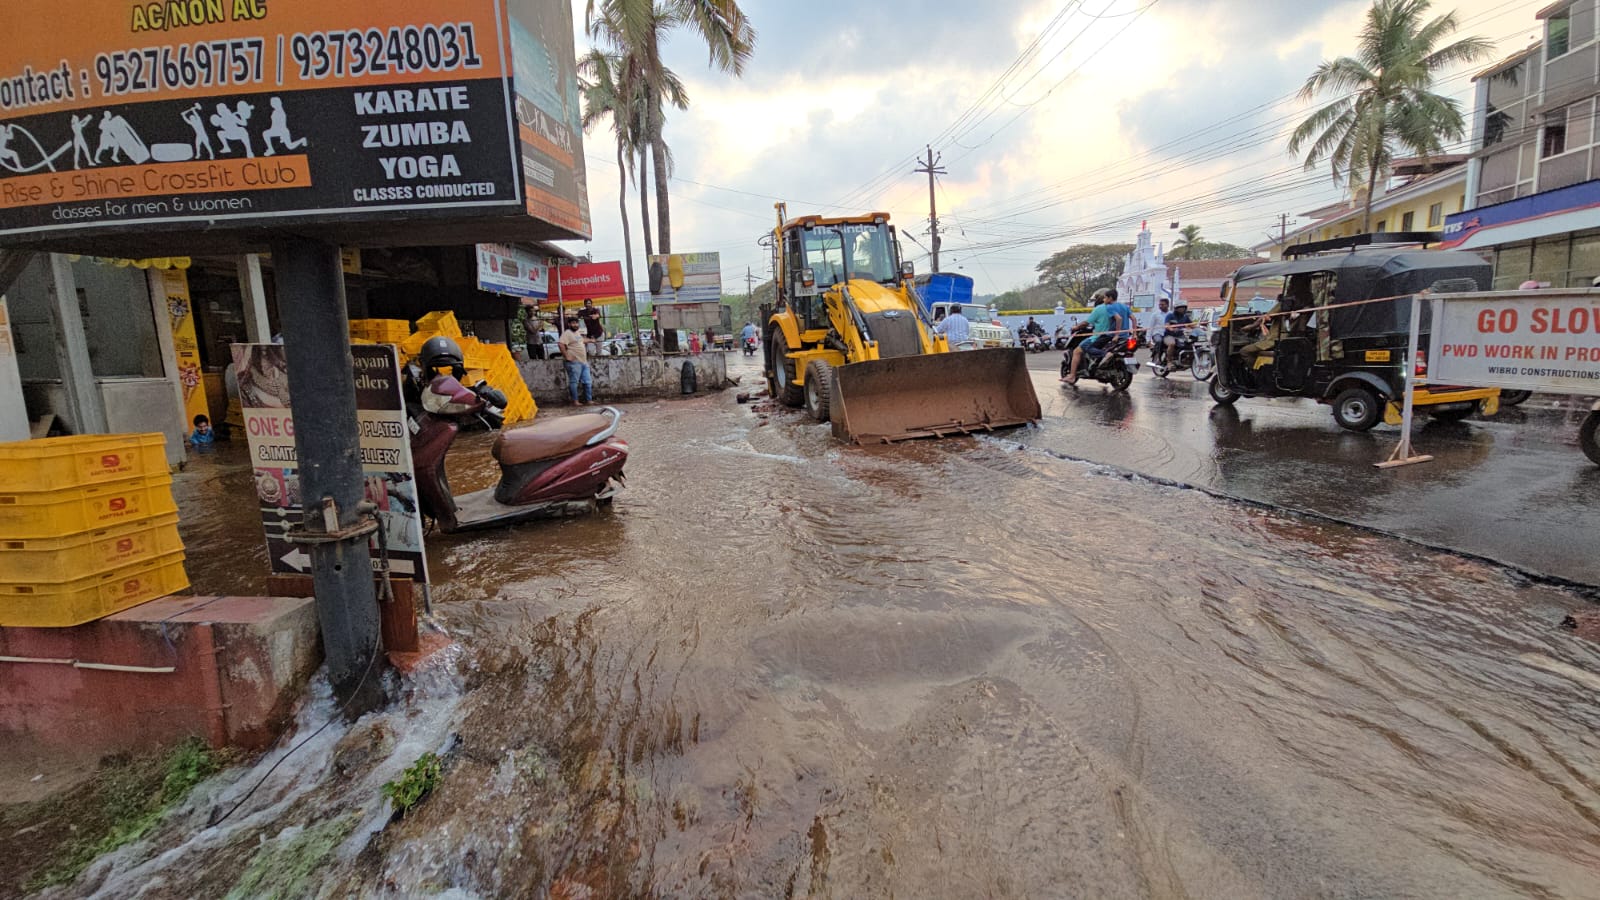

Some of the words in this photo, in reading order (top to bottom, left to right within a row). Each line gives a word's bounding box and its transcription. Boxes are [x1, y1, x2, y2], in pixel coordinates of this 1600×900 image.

[131, 0, 225, 32] AC/NON
[231, 0, 267, 25] AC
[0, 61, 74, 109] ontact
[95, 38, 264, 96] 9527669757
[291, 22, 482, 80] 9373248031
[353, 86, 470, 115] KARATE
[360, 120, 472, 148] ZUMBA
[378, 154, 462, 180] YOGA
[2, 182, 42, 203] Rise
[51, 177, 65, 199] &
[71, 174, 136, 197] Shine
[241, 162, 297, 186] Club
[353, 186, 413, 202] CLASSES
[416, 182, 496, 198] CONDUCTED
[52, 204, 101, 221] classes
[106, 200, 127, 216] for
[132, 201, 169, 214] men
[189, 197, 252, 212] women
[561, 273, 612, 288] asianpaints
[1477, 308, 1519, 334] GO
[352, 355, 390, 370] ayani
[1442, 344, 1479, 358] PWD
[1483, 344, 1534, 360] WORK
[1540, 345, 1559, 360] IN
[1565, 346, 1600, 362] PRO
[355, 375, 390, 390] ellers
[1487, 366, 1518, 375] WIBRO
[1520, 367, 1600, 380] CONSTRUCTIONS
[248, 416, 281, 437] ONE
[283, 416, 295, 437] G
[363, 421, 404, 438] PLATED
[269, 445, 298, 461] IMIT
[360, 448, 400, 465] ELLERY
